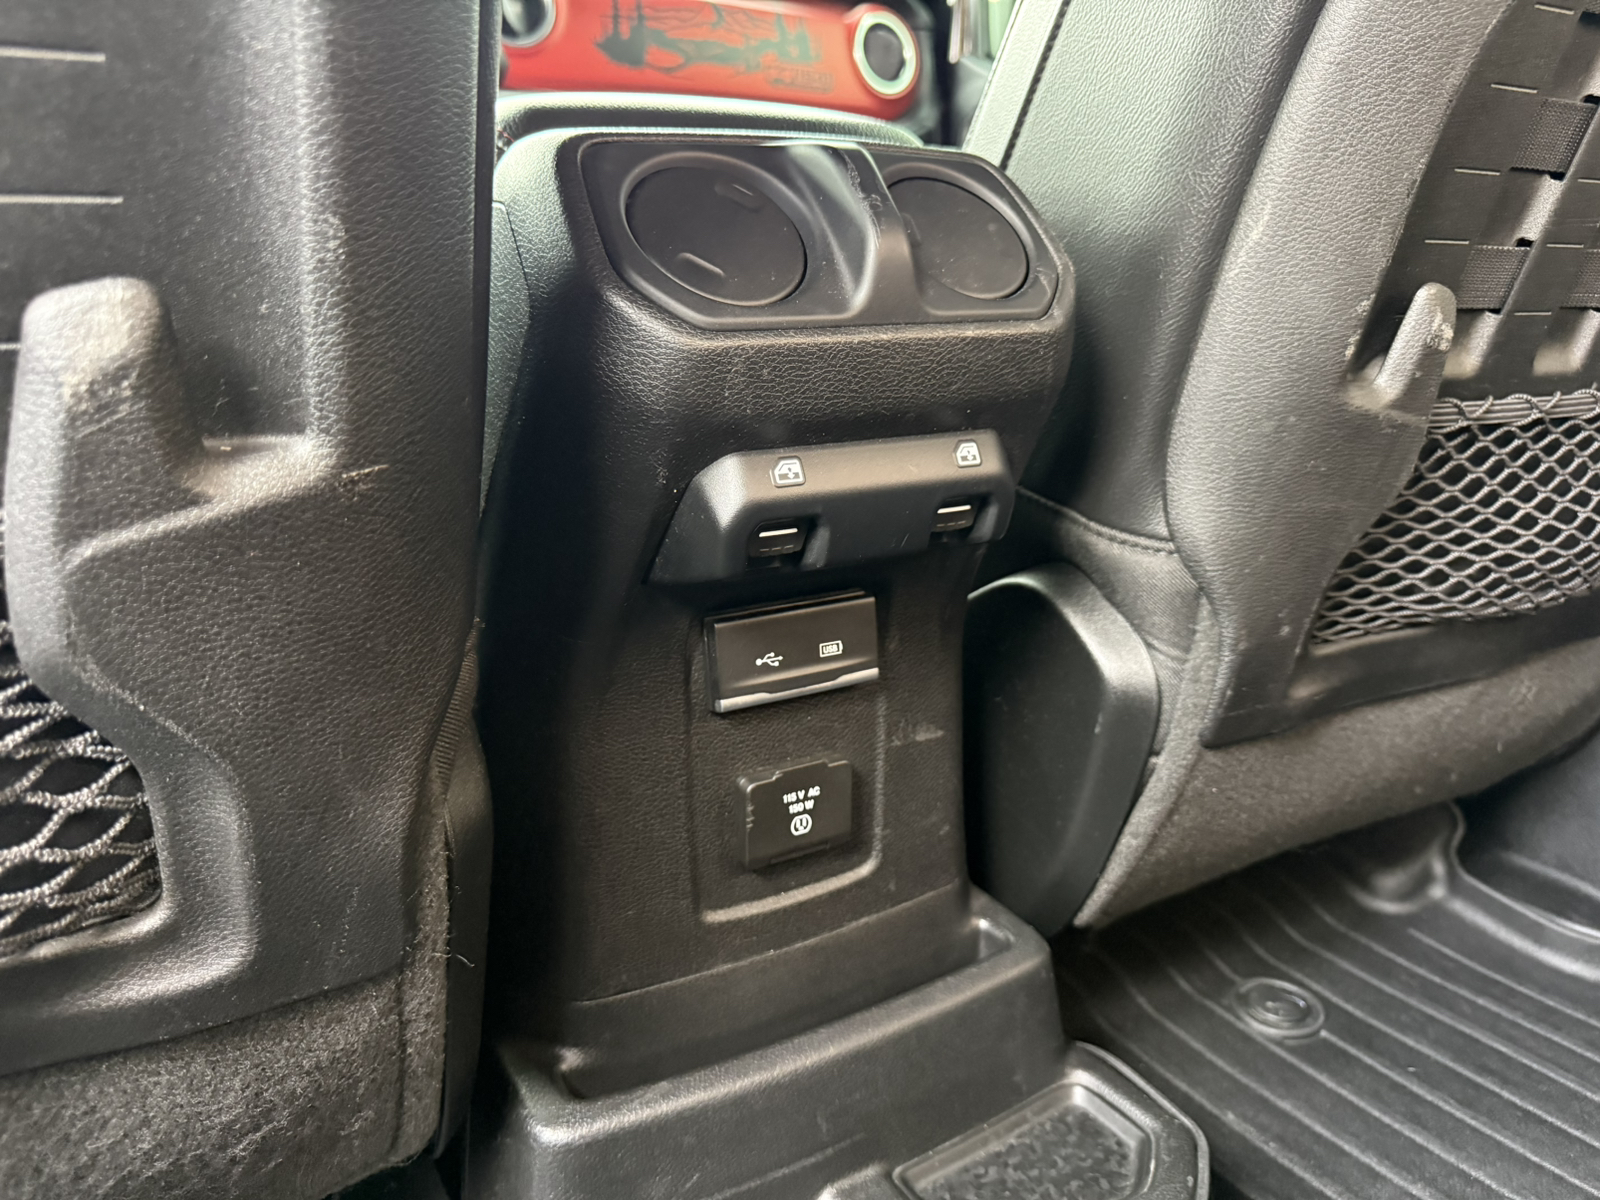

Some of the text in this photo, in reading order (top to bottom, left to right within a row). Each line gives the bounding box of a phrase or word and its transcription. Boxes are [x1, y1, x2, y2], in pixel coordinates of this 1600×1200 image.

[823, 644, 838, 653] USB
[783, 786, 821, 804] 115 V AC
[789, 799, 814, 814] 150 W
